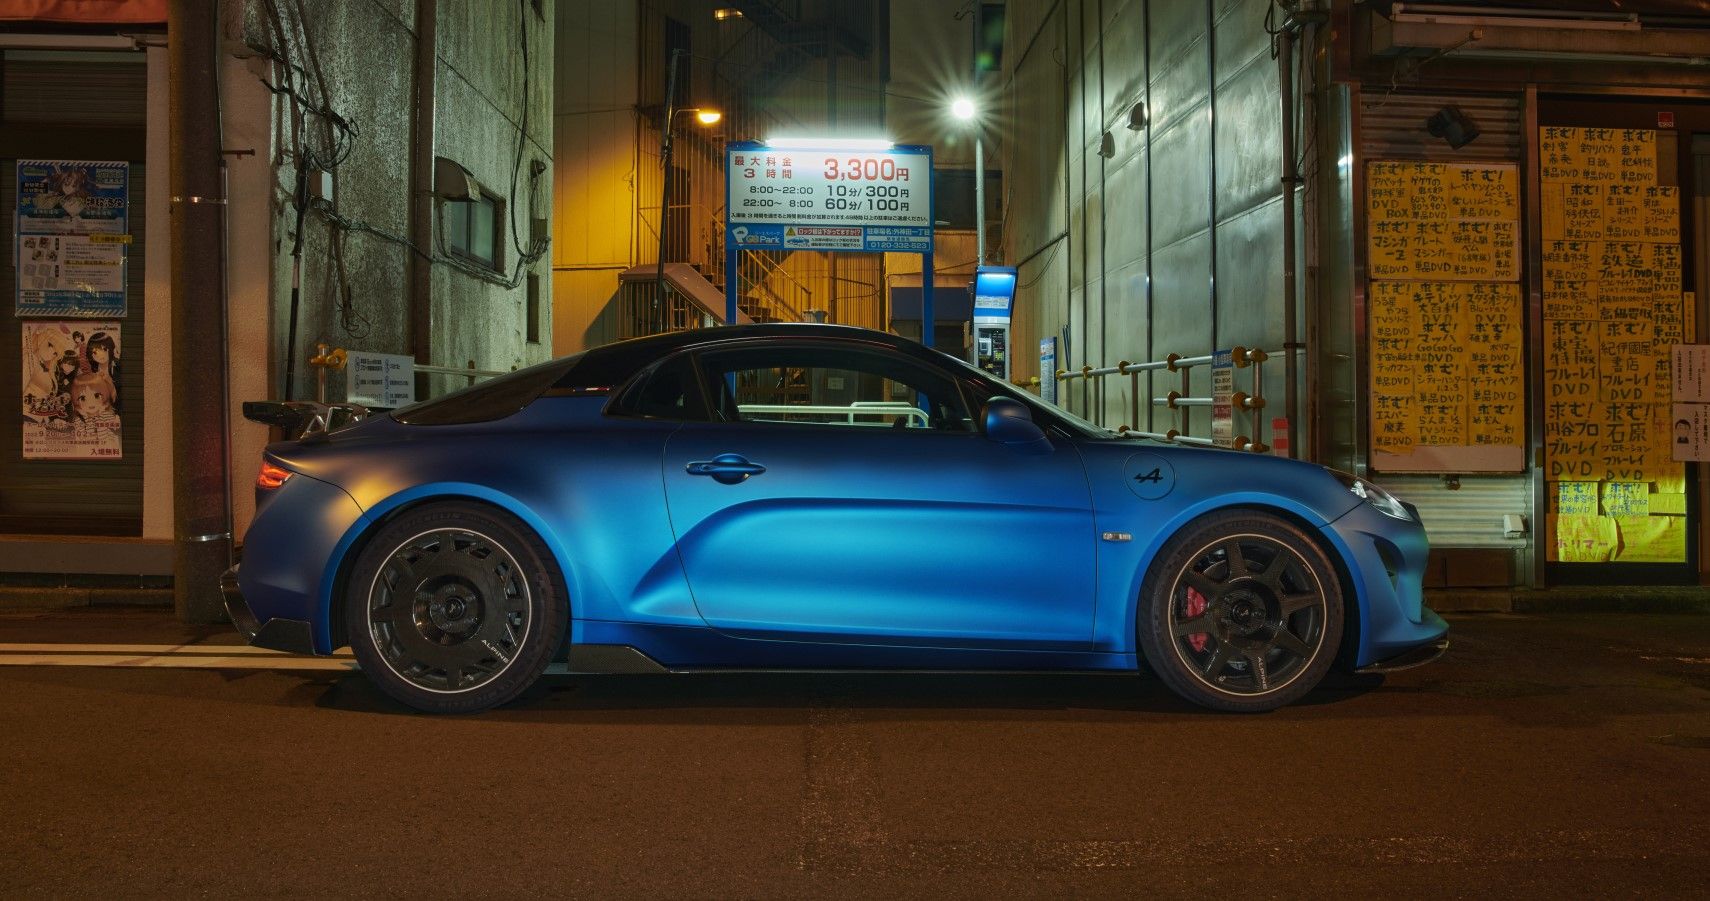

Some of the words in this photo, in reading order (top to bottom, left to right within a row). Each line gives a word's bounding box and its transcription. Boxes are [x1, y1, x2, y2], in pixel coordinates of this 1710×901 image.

[1546, 128, 1576, 139] 求む!
[1585, 129, 1614, 141] 求む!
[1623, 130, 1654, 142] 求む!
[1581, 143, 1615, 153] 釣りバカ
[734, 156, 792, 166] 最大料金
[824, 158, 909, 182] 3,300円
[1415, 164, 1447, 175] 求む!
[1543, 167, 1578, 177] 単品DVD
[1461, 169, 1503, 181] 求む!
[1571, 185, 1599, 195] 求む!
[1610, 186, 1639, 195] 求む!
[1646, 187, 1677, 196] 求む!
[1373, 201, 1398, 209] DVD
[1460, 208, 1500, 217] 単品DVD
[1377, 222, 1408, 233] 求む!
[1417, 222, 1448, 234] 求む!
[1459, 221, 1489, 233] 求む!
[1607, 228, 1640, 237] 単品DVD
[1553, 242, 1588, 251] 求む!
[1606, 243, 1642, 253] 求む!
[1416, 263, 1451, 272] 単品DVD
[1378, 284, 1410, 295] 求む!
[1421, 283, 1455, 293] 求む!
[1474, 283, 1509, 294] 求む!
[1554, 281, 1588, 290] 求む!
[1654, 303, 1680, 313] 求む!
[1377, 328, 1409, 336] 単品DVD
[1424, 323, 1457, 333] 求む!
[1475, 323, 1510, 333] 求む!
[1553, 321, 1592, 335] 求む!
[1608, 322, 1646, 336] 求む!
[1378, 338, 1408, 349] 求む!
[1472, 353, 1510, 361] 単品DVD
[1424, 364, 1458, 374] 求む!
[1478, 364, 1514, 374] 求む!
[1612, 357, 1639, 372] 書店
[1376, 377, 1410, 386] 単品DVD
[1553, 384, 1589, 396] DVD
[1611, 389, 1642, 400] DVD
[1420, 393, 1463, 403] 単品DVD
[1474, 391, 1516, 401] 単品DVD
[1378, 396, 1409, 408] 求む!
[1424, 405, 1457, 415] 求む!
[1478, 405, 1514, 414] 求む!
[1549, 403, 1593, 418] 求む!
[1607, 403, 1649, 420] 求む!
[1607, 423, 1646, 443] 石原
[1376, 437, 1412, 446] 単品DVD
[1420, 436, 1459, 444] 単品DVD
[1476, 435, 1513, 444] 単品DVD
[90, 448, 120, 456] 入場無料
[1552, 461, 1592, 476] DVD
[1606, 470, 1642, 480] DVD
[480, 639, 509, 663] ALPINE
